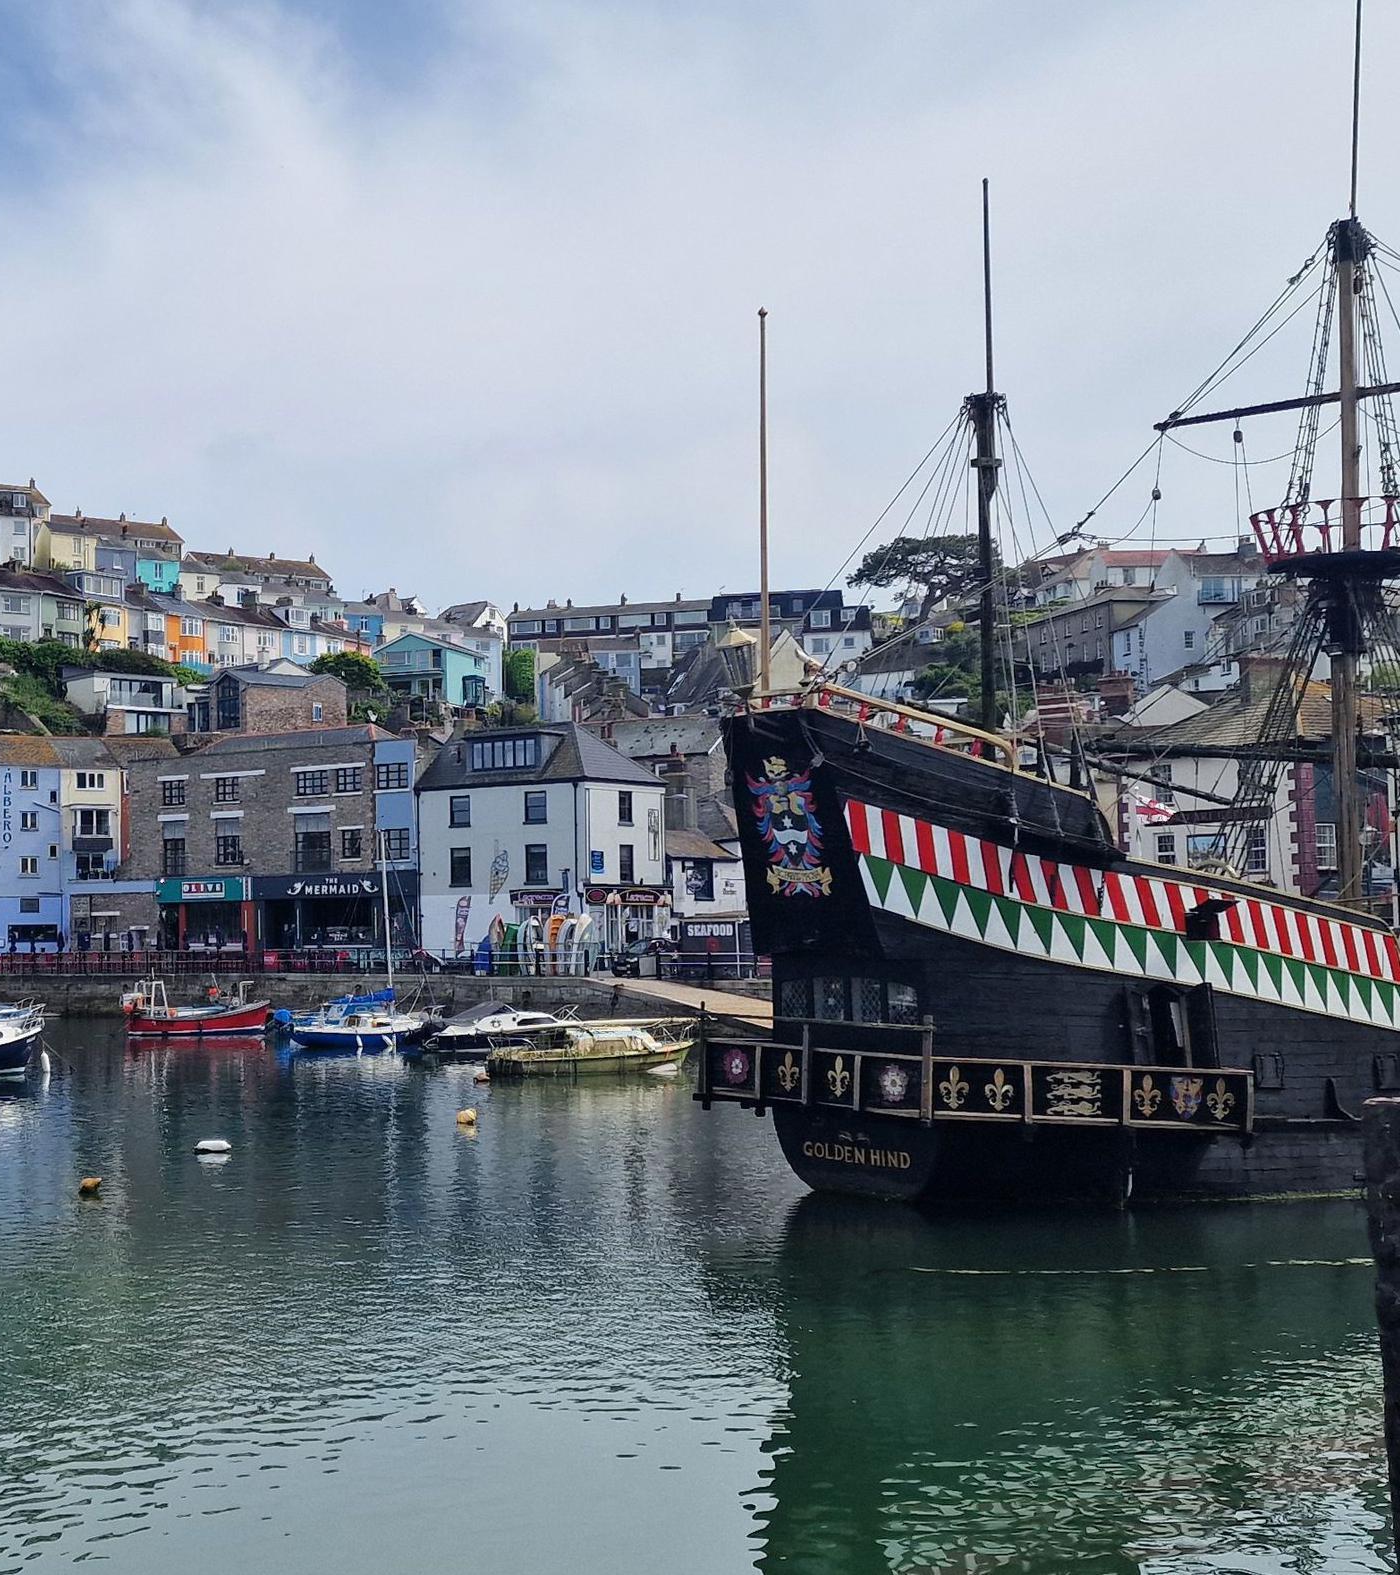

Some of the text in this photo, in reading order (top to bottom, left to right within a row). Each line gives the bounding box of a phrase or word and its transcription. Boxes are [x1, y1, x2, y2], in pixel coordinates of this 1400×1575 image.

[2, 772, 12, 844] ALBERO
[325, 877, 338, 885] THE
[304, 884, 359, 895] MERMAID
[687, 923, 733, 937] SEAFOOD
[803, 1141, 911, 1169] GOLDEN HIND
